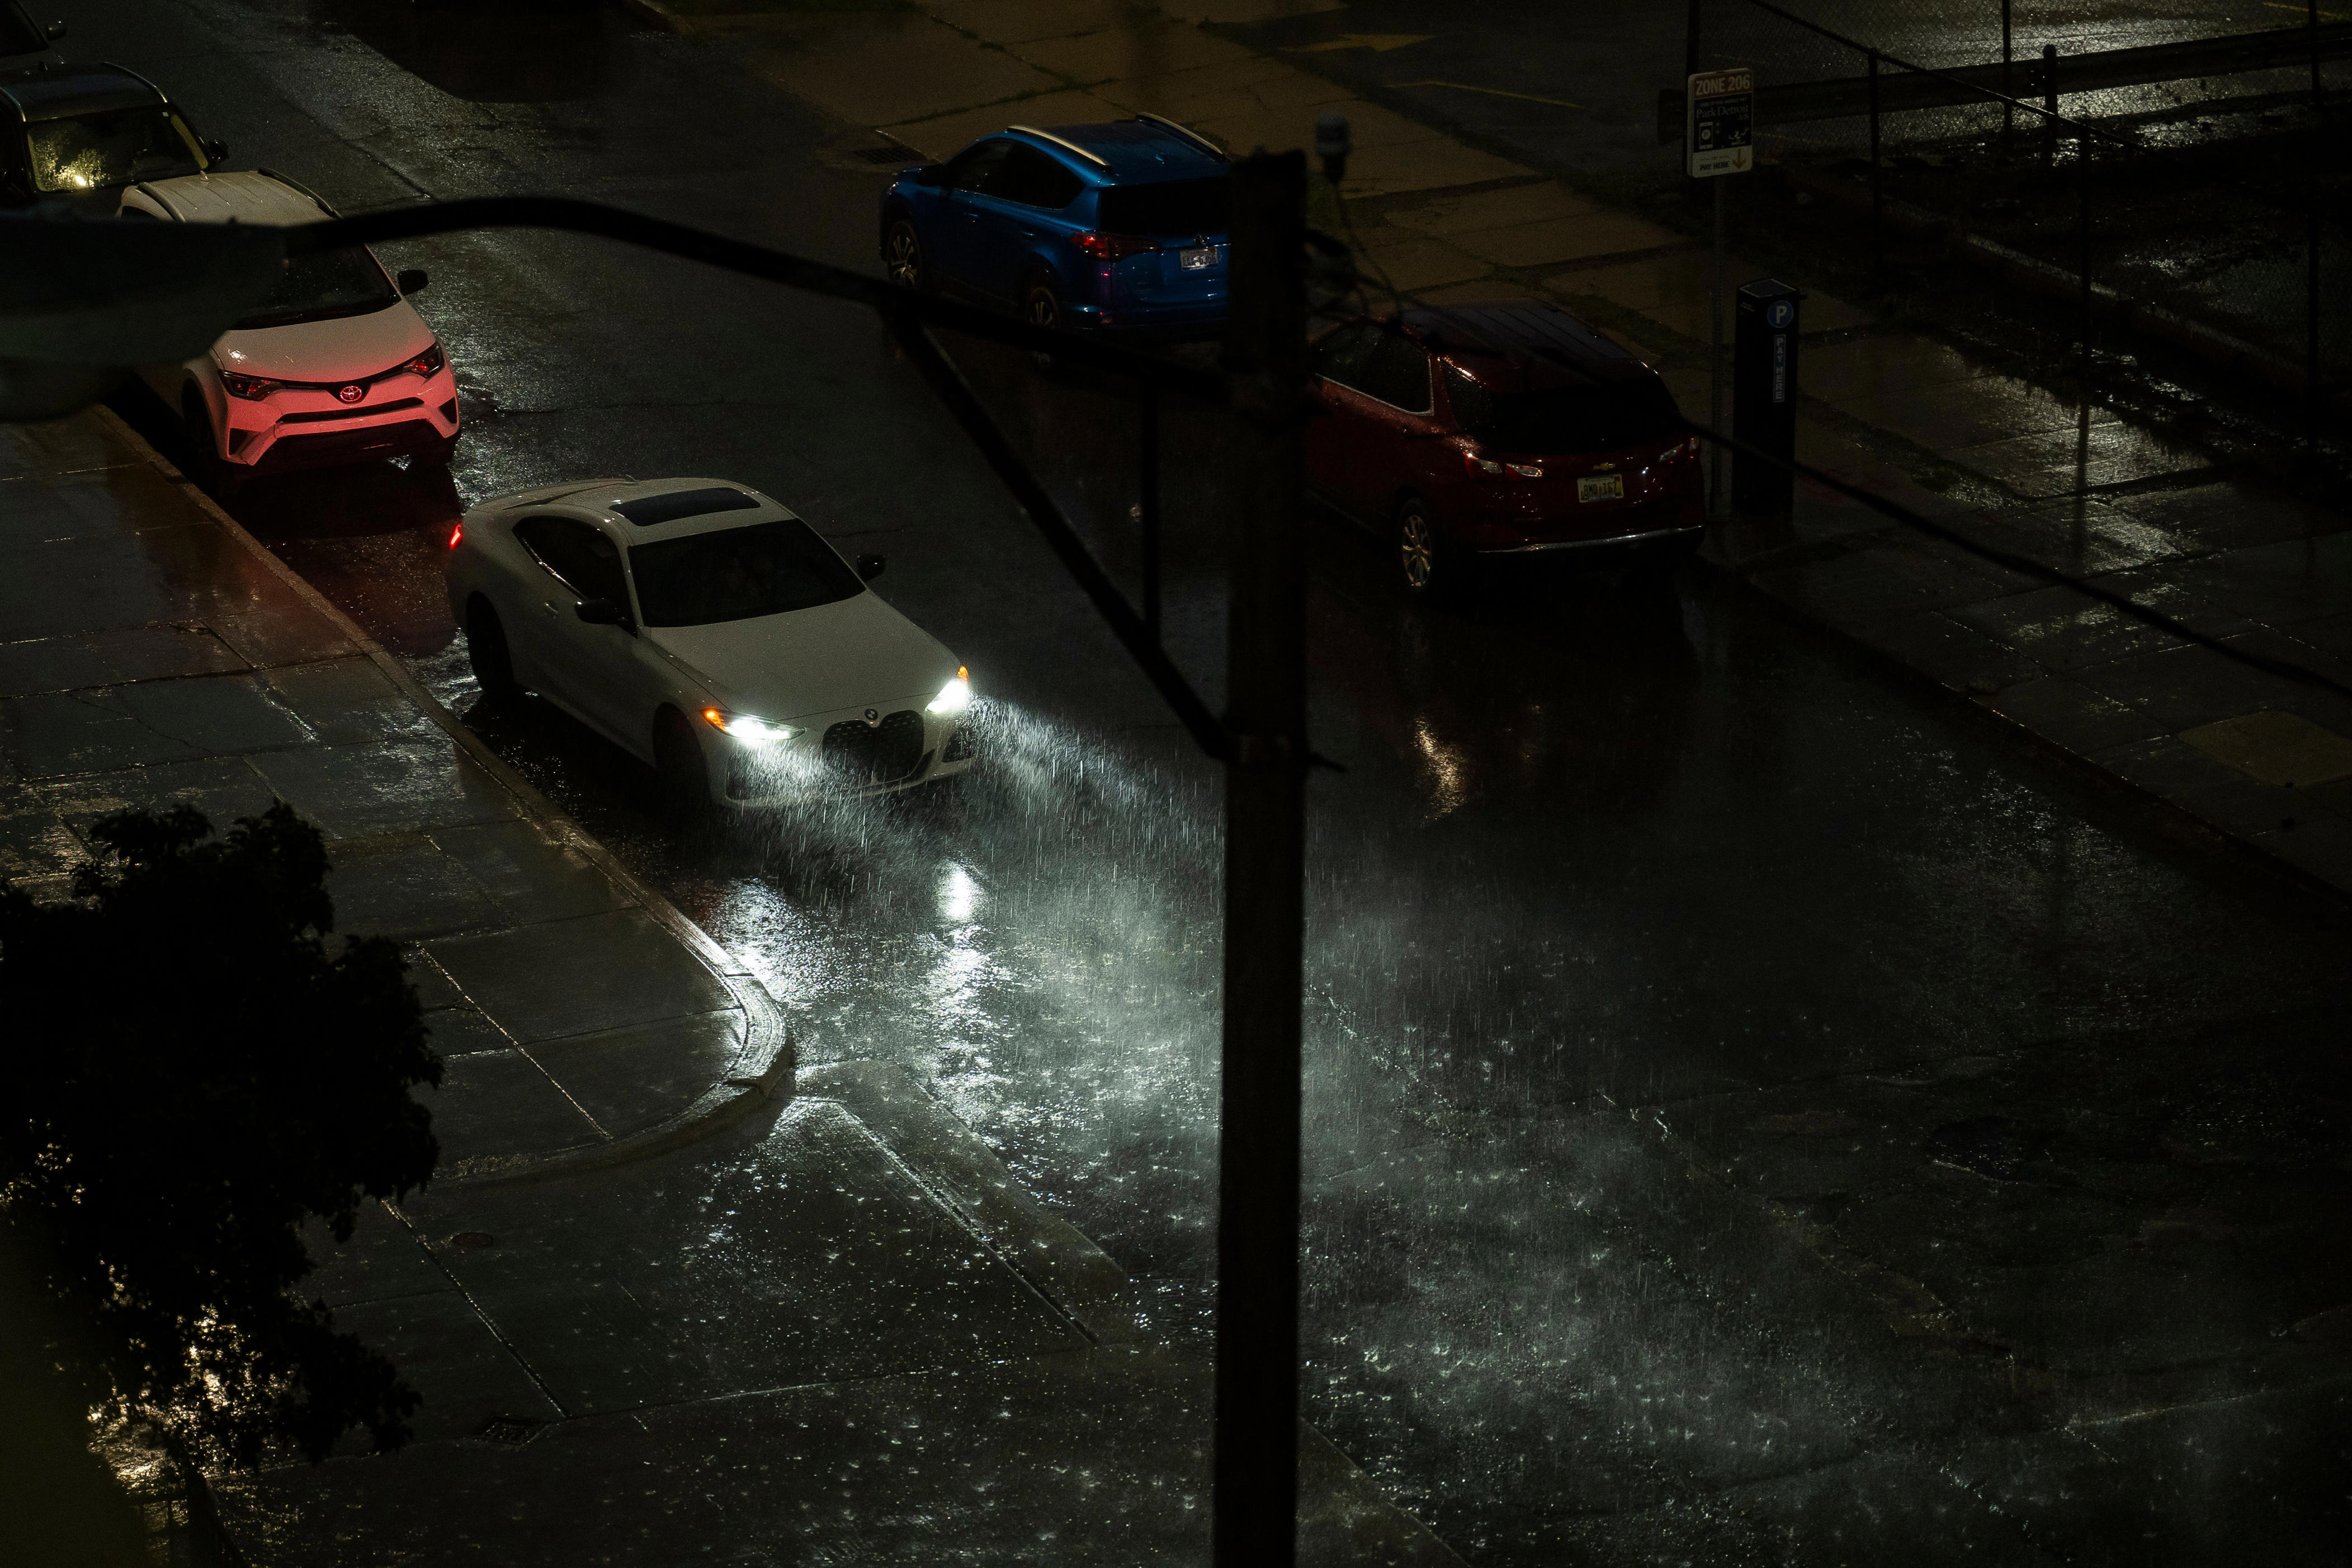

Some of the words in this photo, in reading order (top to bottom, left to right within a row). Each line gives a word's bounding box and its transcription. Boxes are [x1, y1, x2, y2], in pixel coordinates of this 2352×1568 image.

[1695, 77, 1726, 96] ZONE
[1727, 74, 1750, 92] 206
[1696, 106, 1716, 119] Park
[1717, 105, 1749, 116] Detroit
[1713, 160, 1730, 169] HERE
[1775, 305, 1788, 324] P
[1775, 337, 1784, 363] PAY
[1775, 366, 1784, 400] HERE
